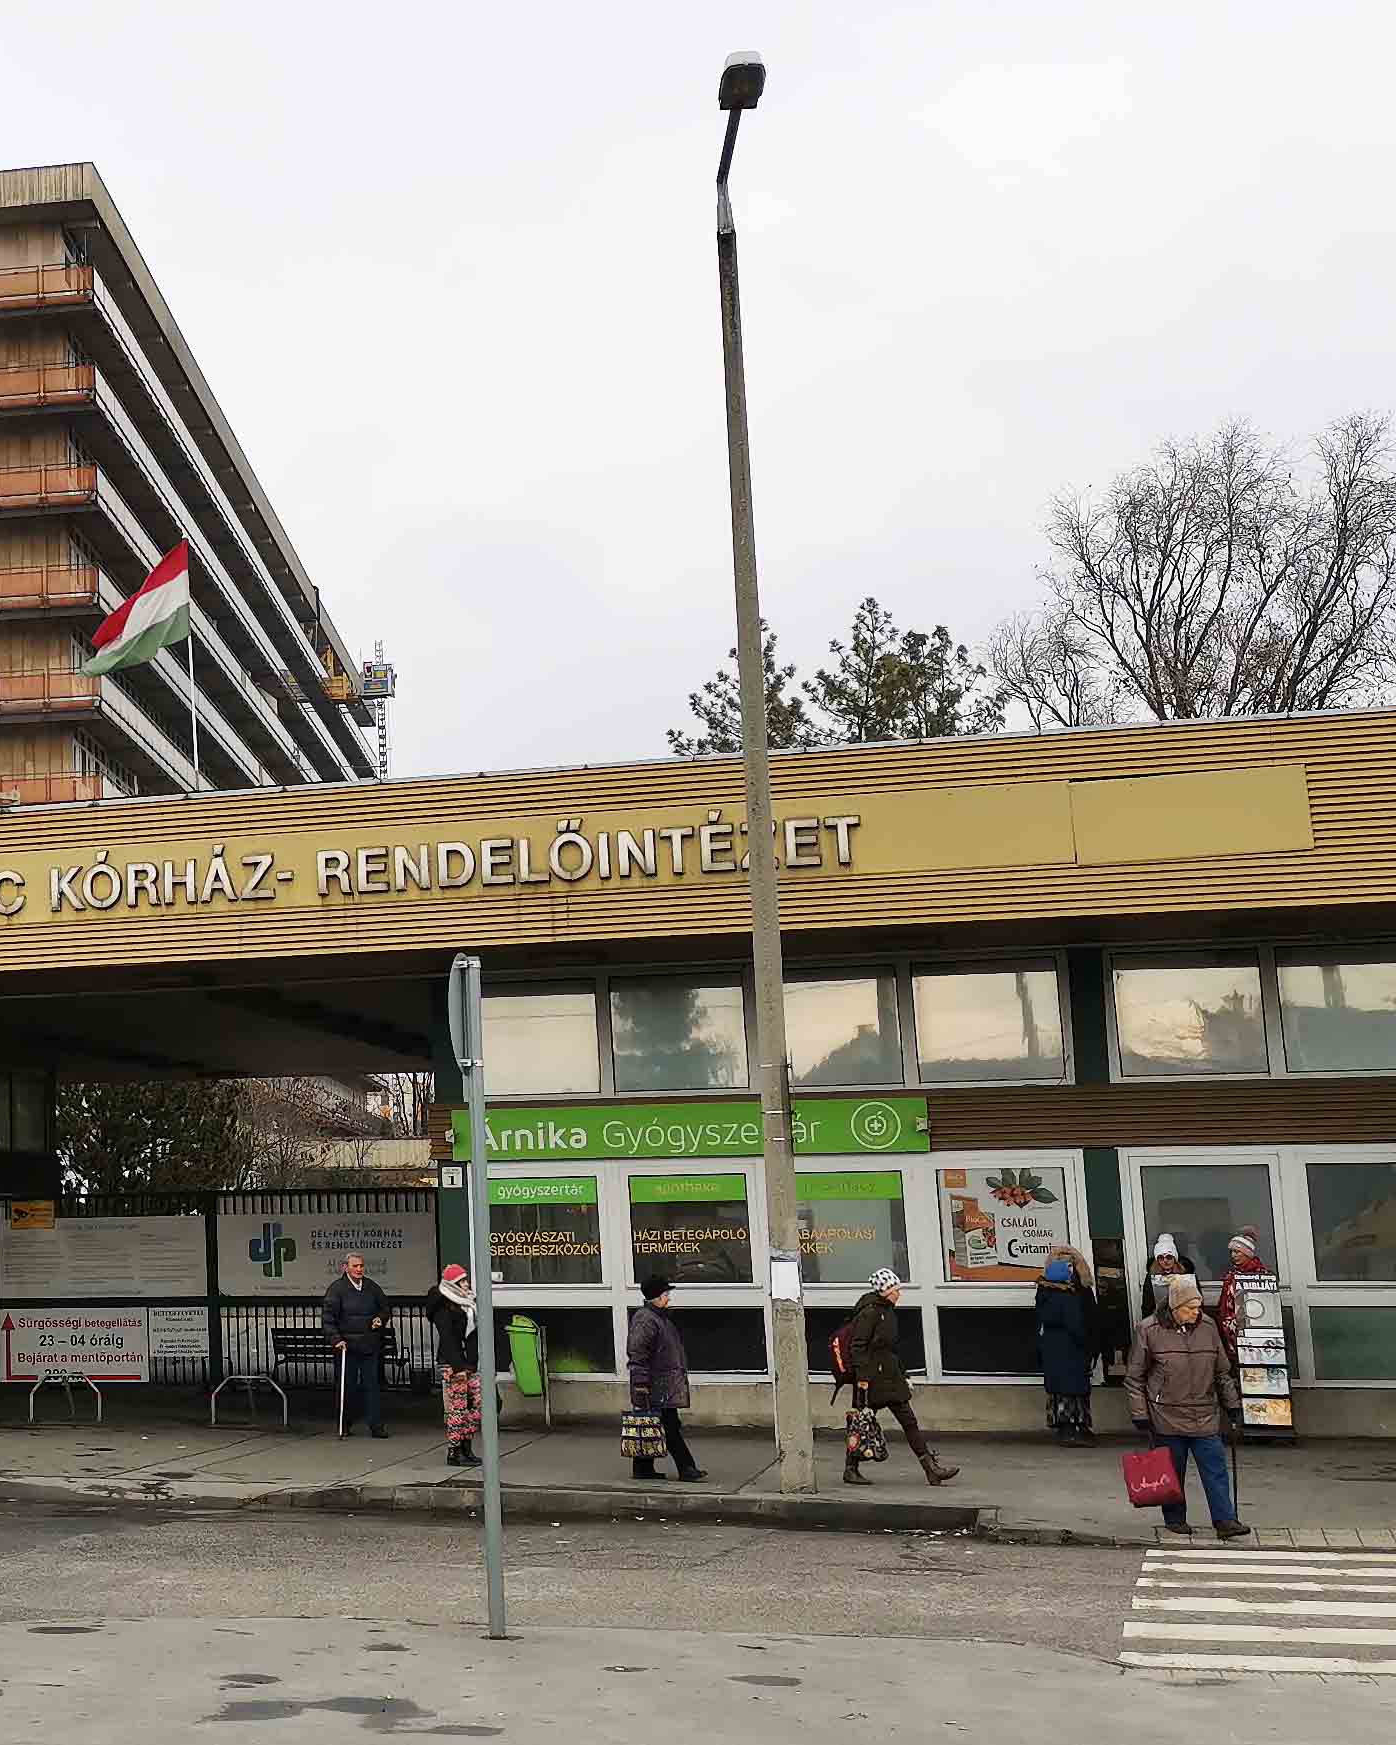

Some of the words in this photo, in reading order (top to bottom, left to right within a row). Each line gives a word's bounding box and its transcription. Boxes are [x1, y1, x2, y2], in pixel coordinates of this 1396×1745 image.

[51, 844, 294, 912] KÓRHÁZ-
[602, 1111, 822, 1155] Gyógyszeár
[497, 1183, 584, 1199] gyógyszertár
[1001, 1216, 1037, 1229] CSALÁDI
[489, 1230, 575, 1243] GYÓGYÁSZATI
[634, 1228, 661, 1241] HÁZI
[664, 1227, 747, 1241] BETEGÁPOLÓ
[1023, 1229, 1053, 1238] CSOMAG
[489, 1243, 599, 1256] SEGÉDESZKÖZÖK
[635, 1240, 700, 1254] TERMÉKEK
[1007, 1238, 1052, 1259] C-vitami
[18, 1318, 81, 1329] Sürgősségi
[84, 1318, 142, 1329] betegellátás
[39, 1334, 54, 1346] 23
[70, 1334, 85, 1346] 04
[90, 1333, 124, 1348] óráig
[17, 1352, 58, 1365] Bejárat
[60, 1355, 67, 1363] a
[70, 1352, 144, 1364] mentőportán
